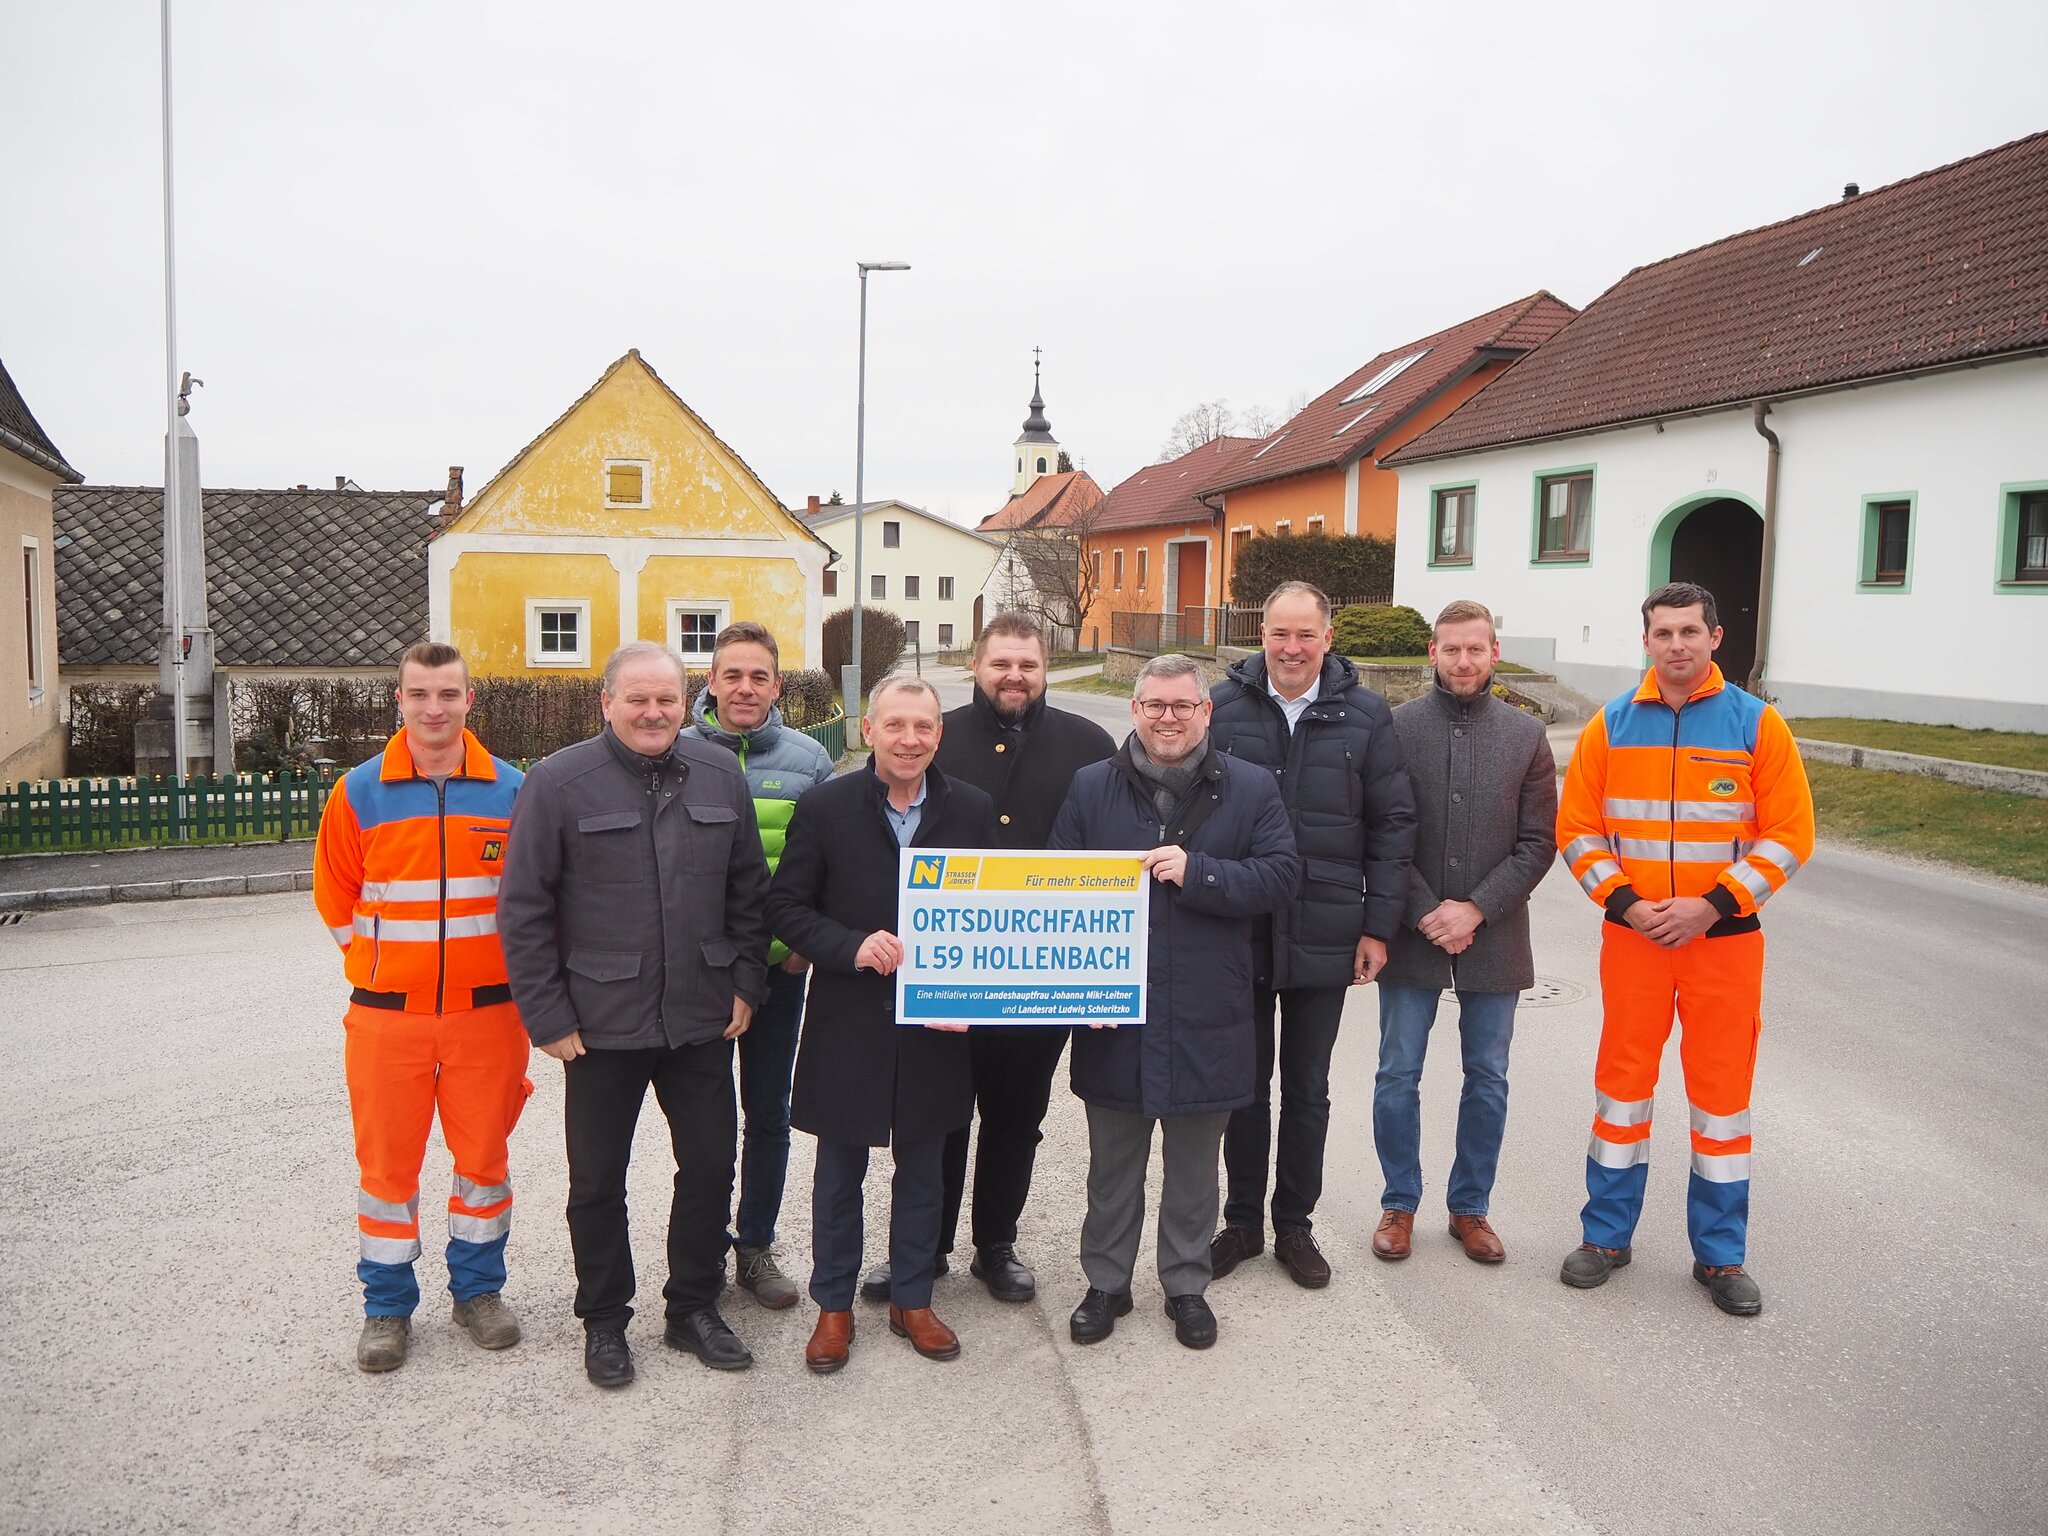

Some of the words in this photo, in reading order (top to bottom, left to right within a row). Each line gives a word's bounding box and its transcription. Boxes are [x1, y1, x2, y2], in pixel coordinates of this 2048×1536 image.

[1025, 875, 1044, 886] Für
[1047, 875, 1076, 887] mehr
[1079, 875, 1135, 887] Sicherheit
[913, 907, 1135, 933] ORTSDURCHFAHRT
[915, 945, 927, 969] L
[932, 945, 963, 970] 59
[973, 946, 1130, 970] HOLLENBACH
[917, 990, 933, 999] Eine
[934, 990, 968, 1000] Initiative
[969, 992, 985, 1000] von
[984, 991, 1049, 1001] Landeshauptfrau
[1051, 991, 1084, 1000] Johanna
[1002, 1005, 1016, 1014] und
[1018, 1005, 1057, 1014] Landesrat
[1058, 1005, 1085, 1015] Ludwig
